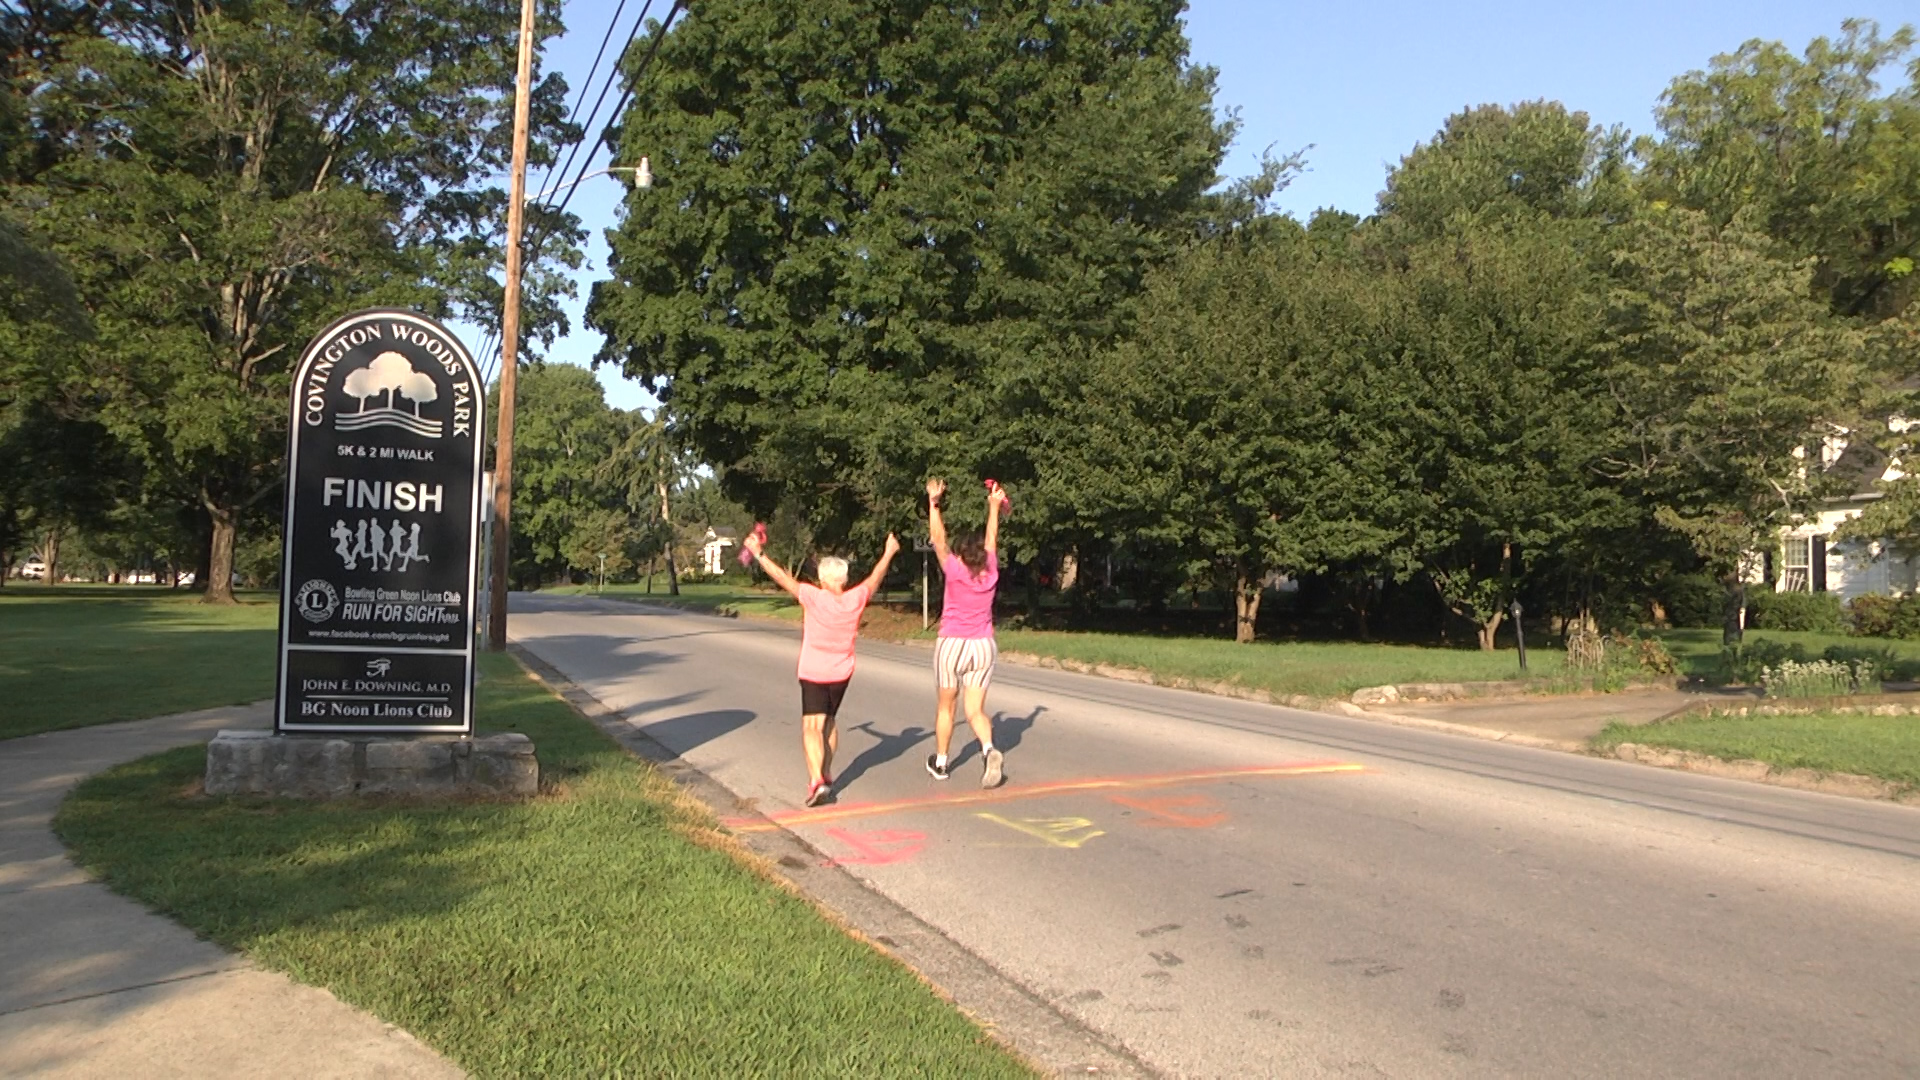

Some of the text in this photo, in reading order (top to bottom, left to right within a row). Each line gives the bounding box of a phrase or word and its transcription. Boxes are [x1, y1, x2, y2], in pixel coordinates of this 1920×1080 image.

[305, 323, 470, 438] COVINGTON WOODS PARK
[337, 445, 434, 461] 5K & 2 MI WALK
[323, 477, 443, 513] FINISH
[311, 593, 323, 608] L
[345, 586, 375, 602] Bowling
[376, 587, 399, 600] Green
[400, 590, 420, 601] Noon
[422, 590, 442, 602] Lions
[443, 590, 461, 603] Club
[342, 603, 372, 620] RUN
[374, 604, 402, 622] FOR
[404, 605, 445, 623] SIGHT
[302, 679, 338, 691] JOHN
[426, 683, 453, 694] M.D.
[301, 701, 453, 718] BG Noon Lions Club
